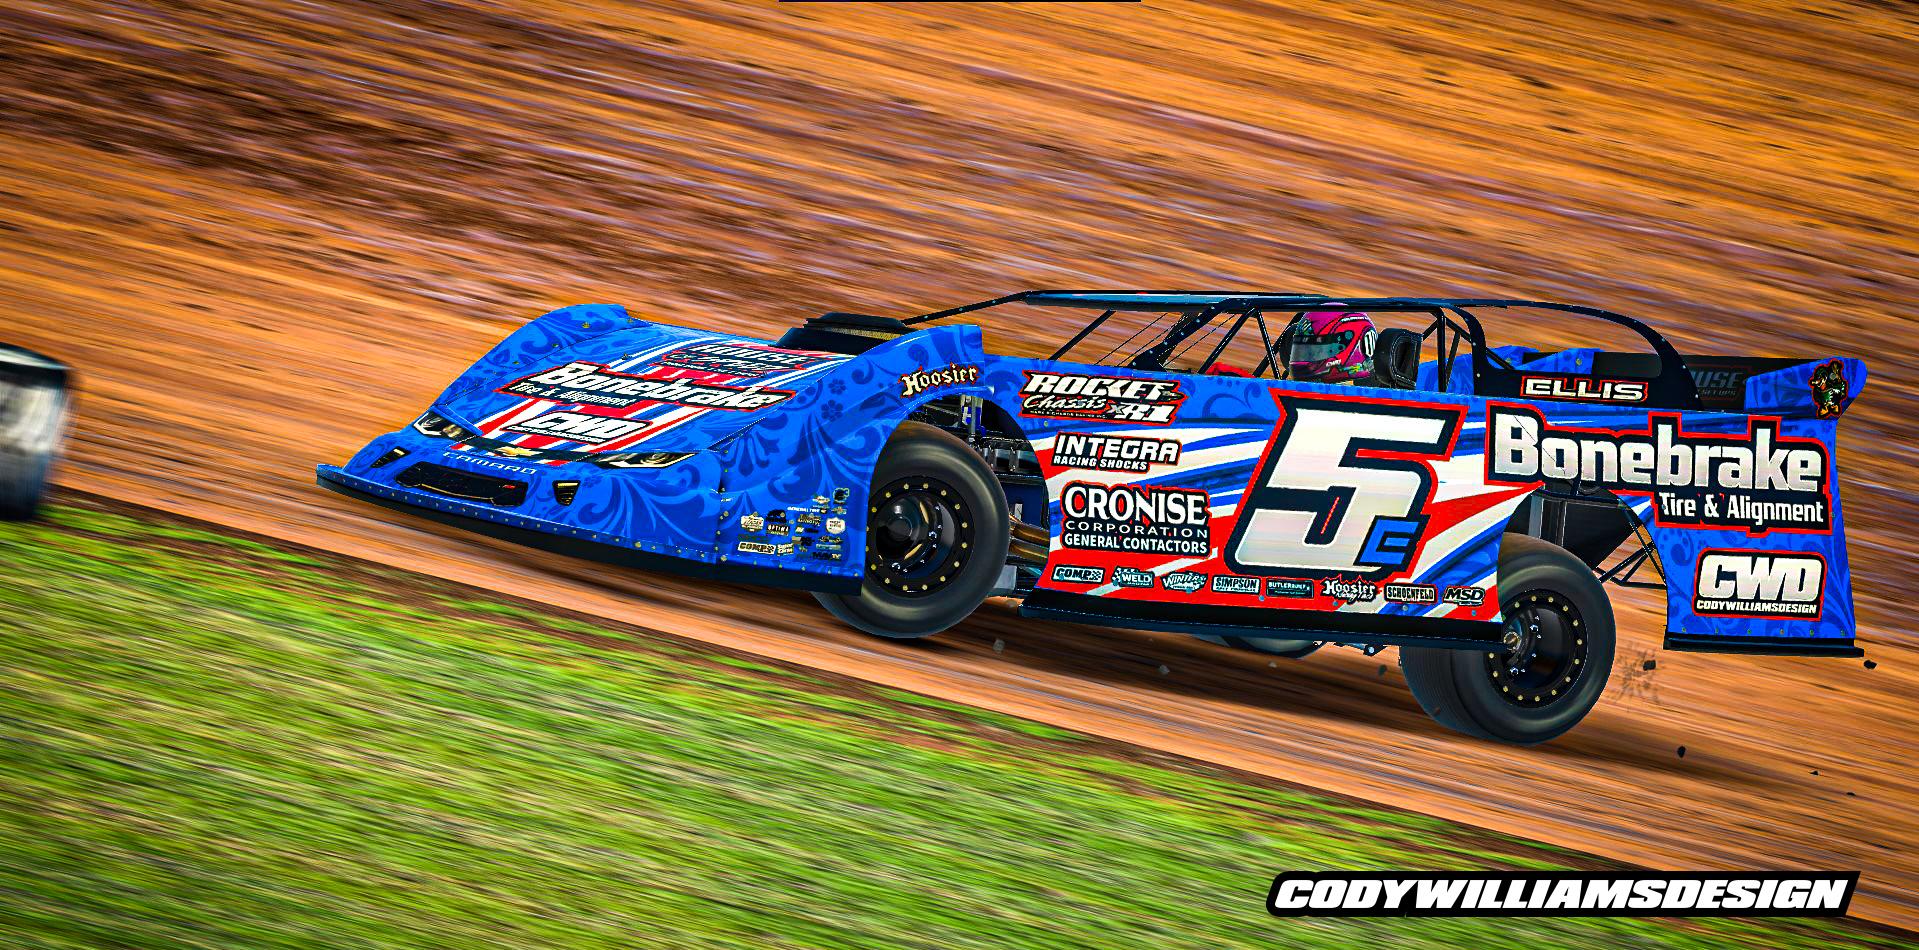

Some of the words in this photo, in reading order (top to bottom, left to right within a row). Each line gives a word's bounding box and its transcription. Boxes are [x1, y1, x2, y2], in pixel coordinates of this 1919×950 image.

[528, 362, 790, 408] Bonebrake
[902, 363, 977, 396] Hoosier
[1025, 373, 1176, 401] ROCKET
[1525, 377, 1644, 400] ELLIS
[1690, 371, 1744, 389] USE
[1024, 394, 1107, 410] Chassis
[519, 411, 646, 438] CWD
[1056, 434, 1179, 462] INTEGRA
[1494, 412, 1823, 492] Bonebrake
[443, 452, 538, 475] CAMARO
[1053, 455, 1097, 467] RACING
[1099, 458, 1148, 471] SHOCKS
[1064, 486, 1208, 525] CRONISE
[1660, 491, 1697, 517] Tire
[1704, 496, 1720, 519] &
[1726, 494, 1825, 527] Alignment
[1065, 520, 1208, 539] CORPORATION
[1064, 532, 1120, 549] GENERAL
[1122, 536, 1208, 554] CONTACTORS
[1121, 574, 1151, 583] WELD
[1215, 577, 1257, 589] SIMPSON
[1322, 579, 1377, 595] Hoosier
[1698, 554, 1823, 602] CWD
[1387, 586, 1435, 600] SCHOENFELD
[1444, 587, 1484, 601] MSD
[1696, 599, 1818, 614] CODYWILLIAMSDESIGN
